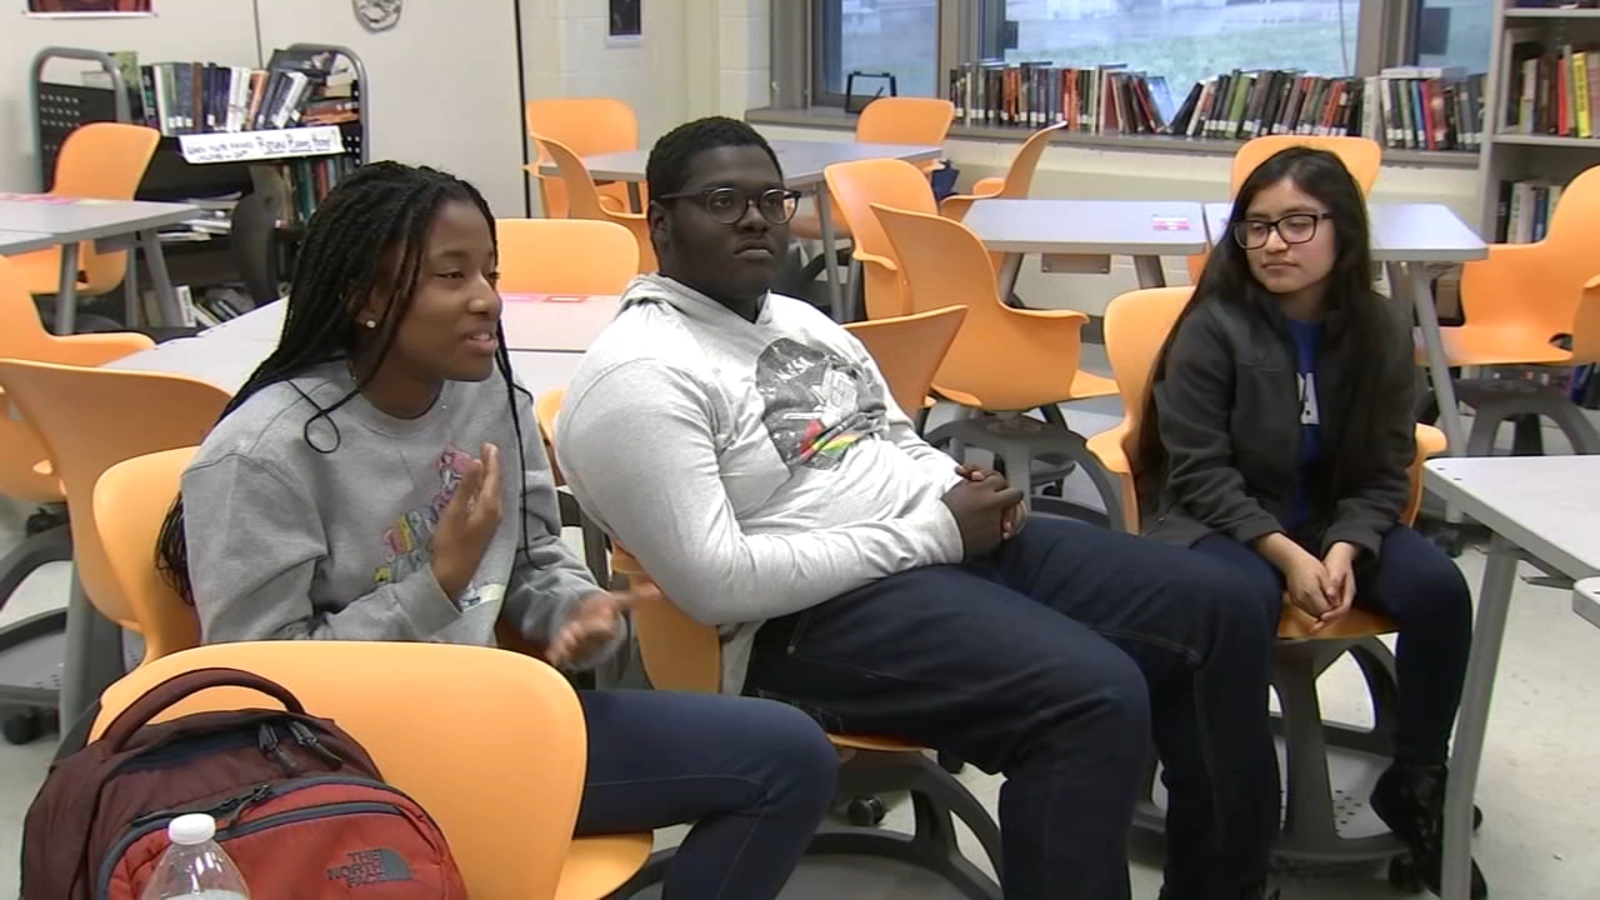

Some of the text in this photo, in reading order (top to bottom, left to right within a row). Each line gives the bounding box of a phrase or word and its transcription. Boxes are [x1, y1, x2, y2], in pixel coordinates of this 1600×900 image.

[347, 848, 381, 863] THE
[326, 861, 386, 881] NORTH
[346, 872, 387, 888] FACE
